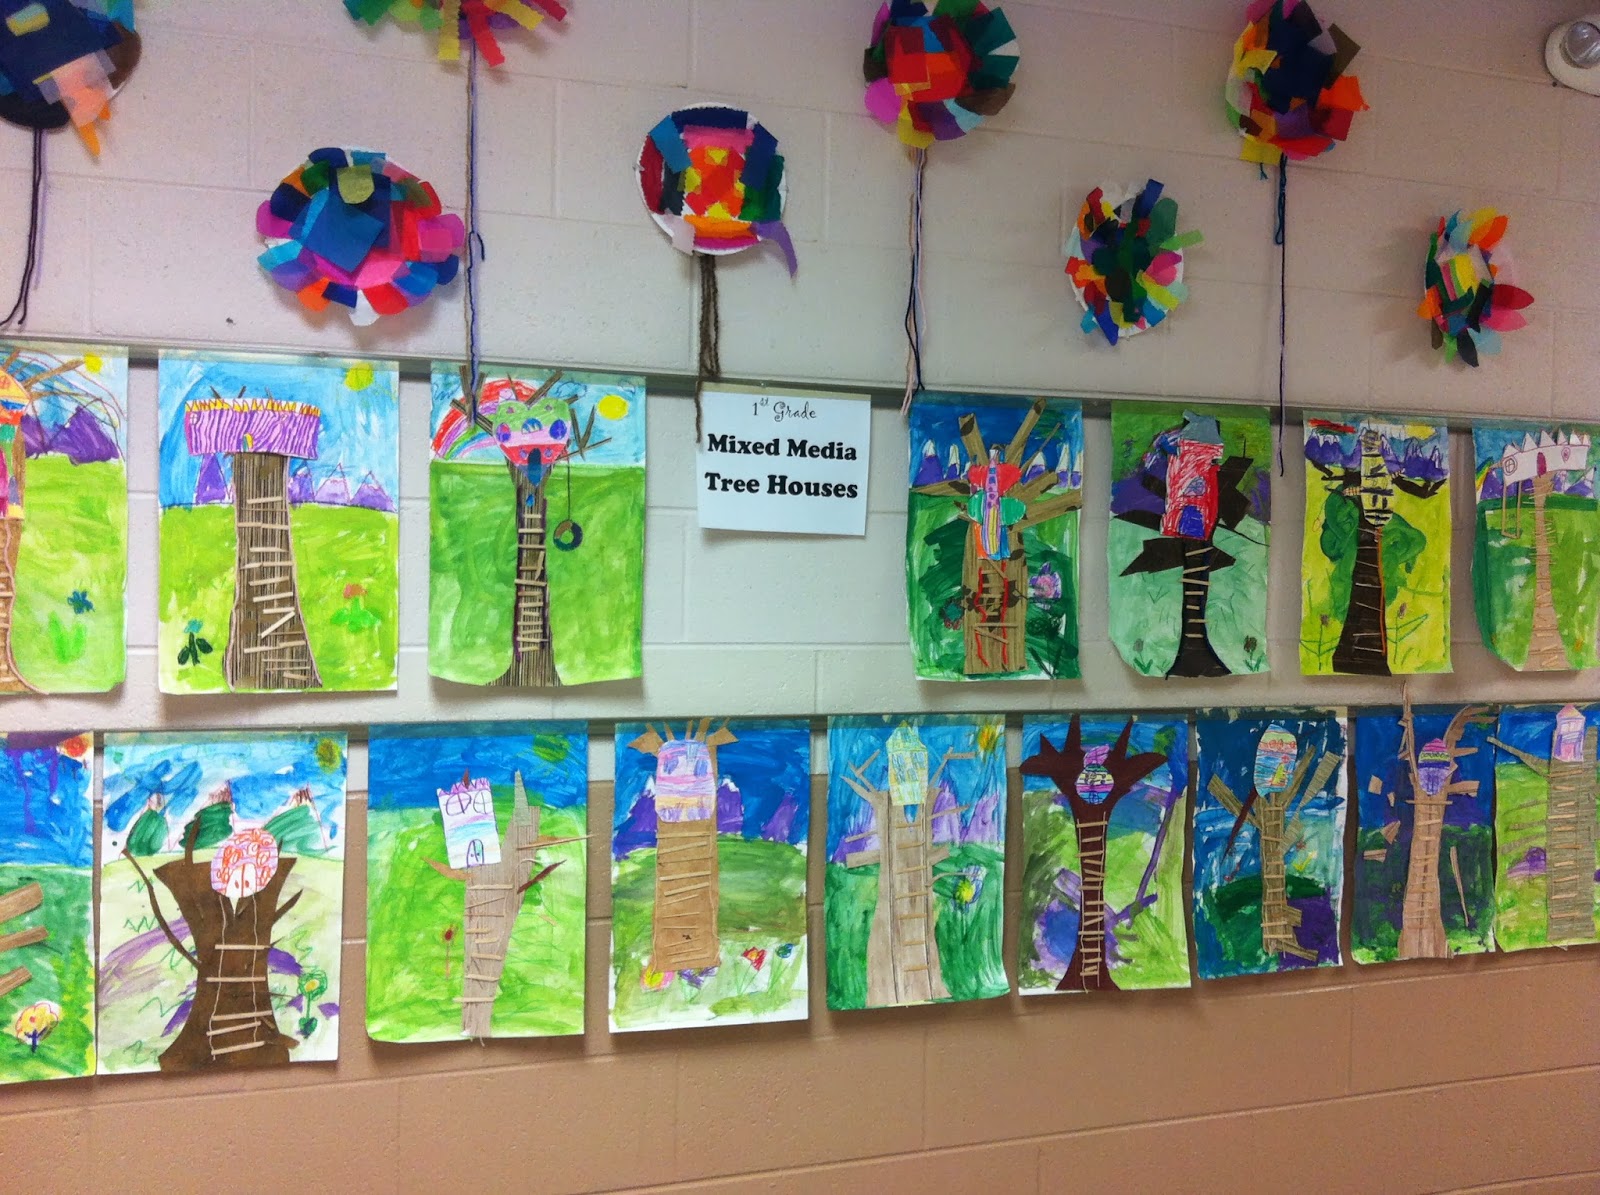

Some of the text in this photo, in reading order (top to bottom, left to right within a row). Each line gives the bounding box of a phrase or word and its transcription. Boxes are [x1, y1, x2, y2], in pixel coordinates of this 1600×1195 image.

[752, 397, 817, 422] 1st Grade
[707, 433, 857, 461] Mixed Media
[704, 471, 858, 499] Tree Houses
